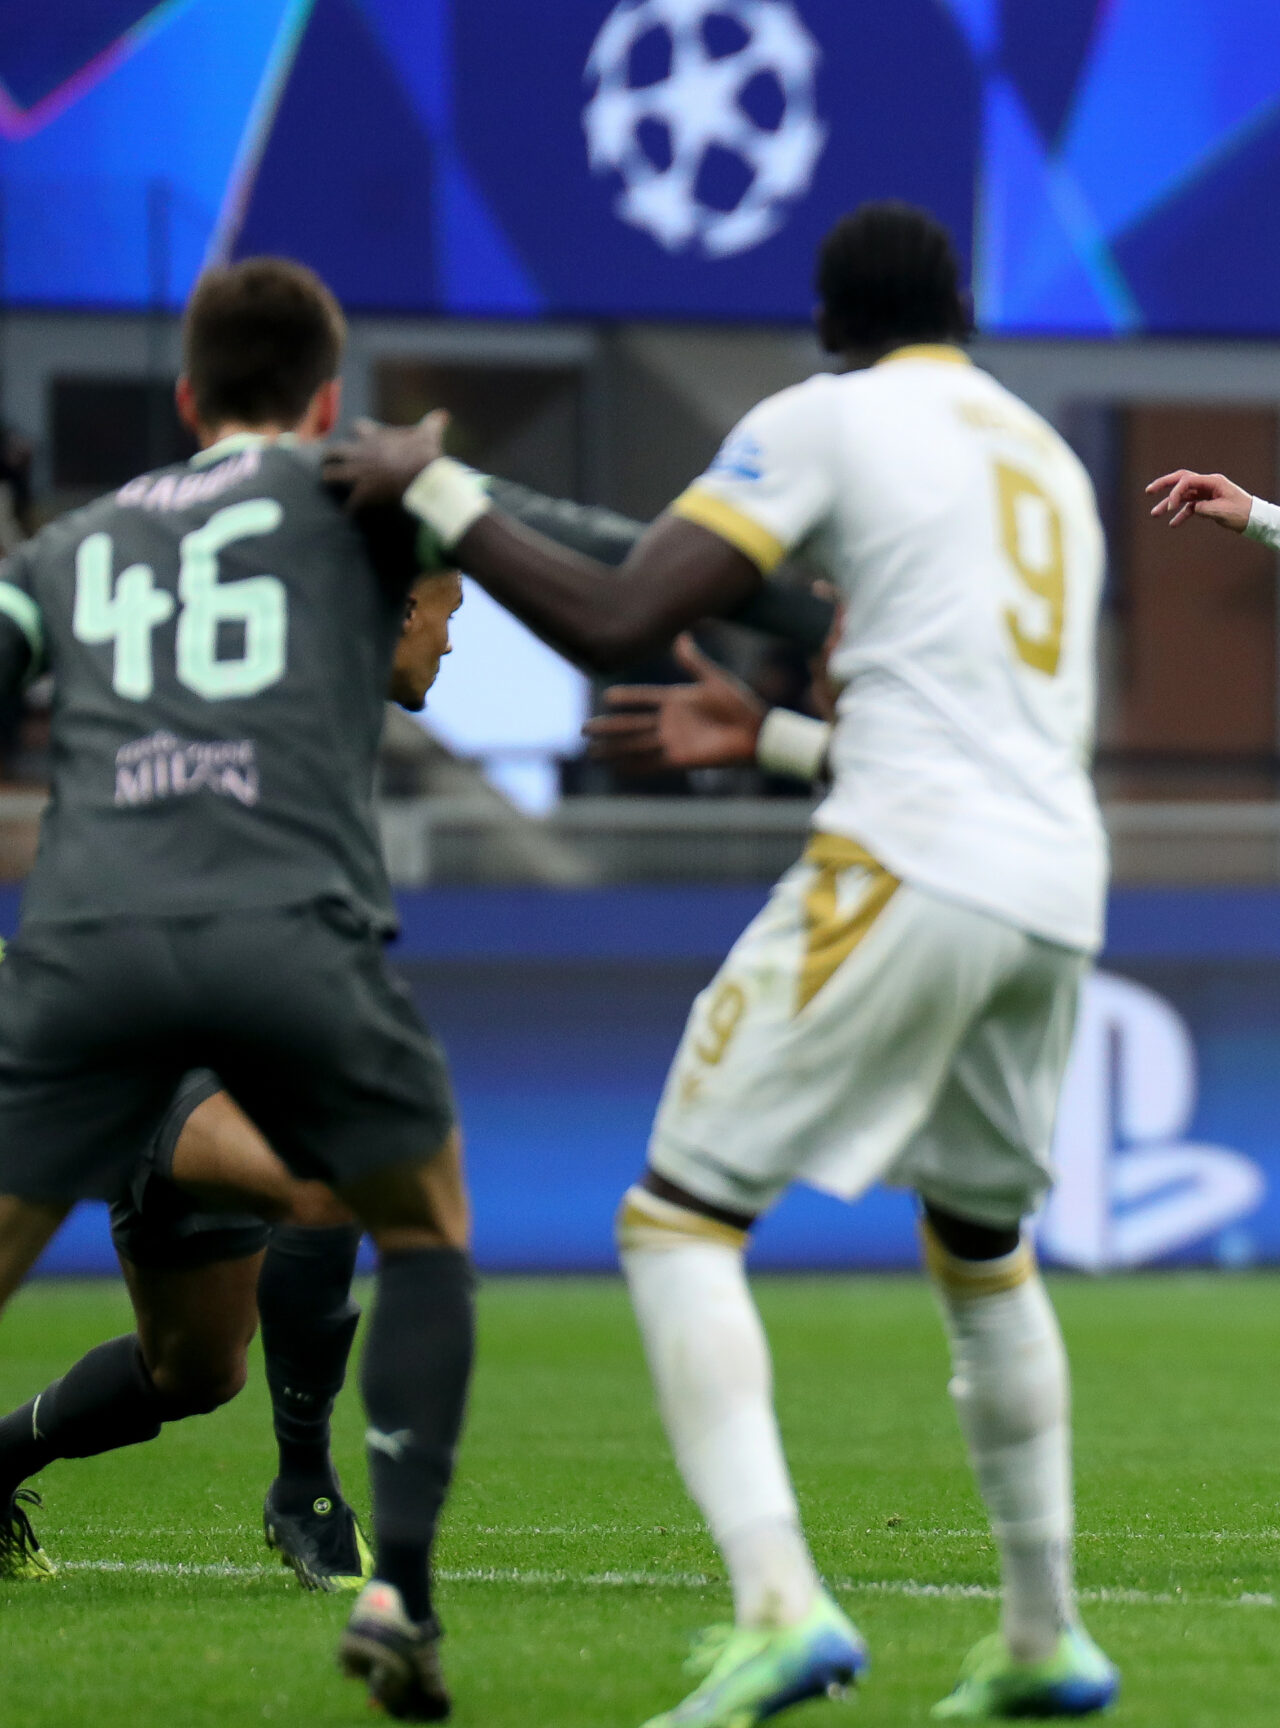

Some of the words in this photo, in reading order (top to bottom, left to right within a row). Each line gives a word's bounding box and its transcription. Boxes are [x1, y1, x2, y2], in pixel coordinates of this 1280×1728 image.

[73, 498, 287, 702] 46
[994, 462, 1066, 678] 9
[695, 981, 747, 1066] 9
